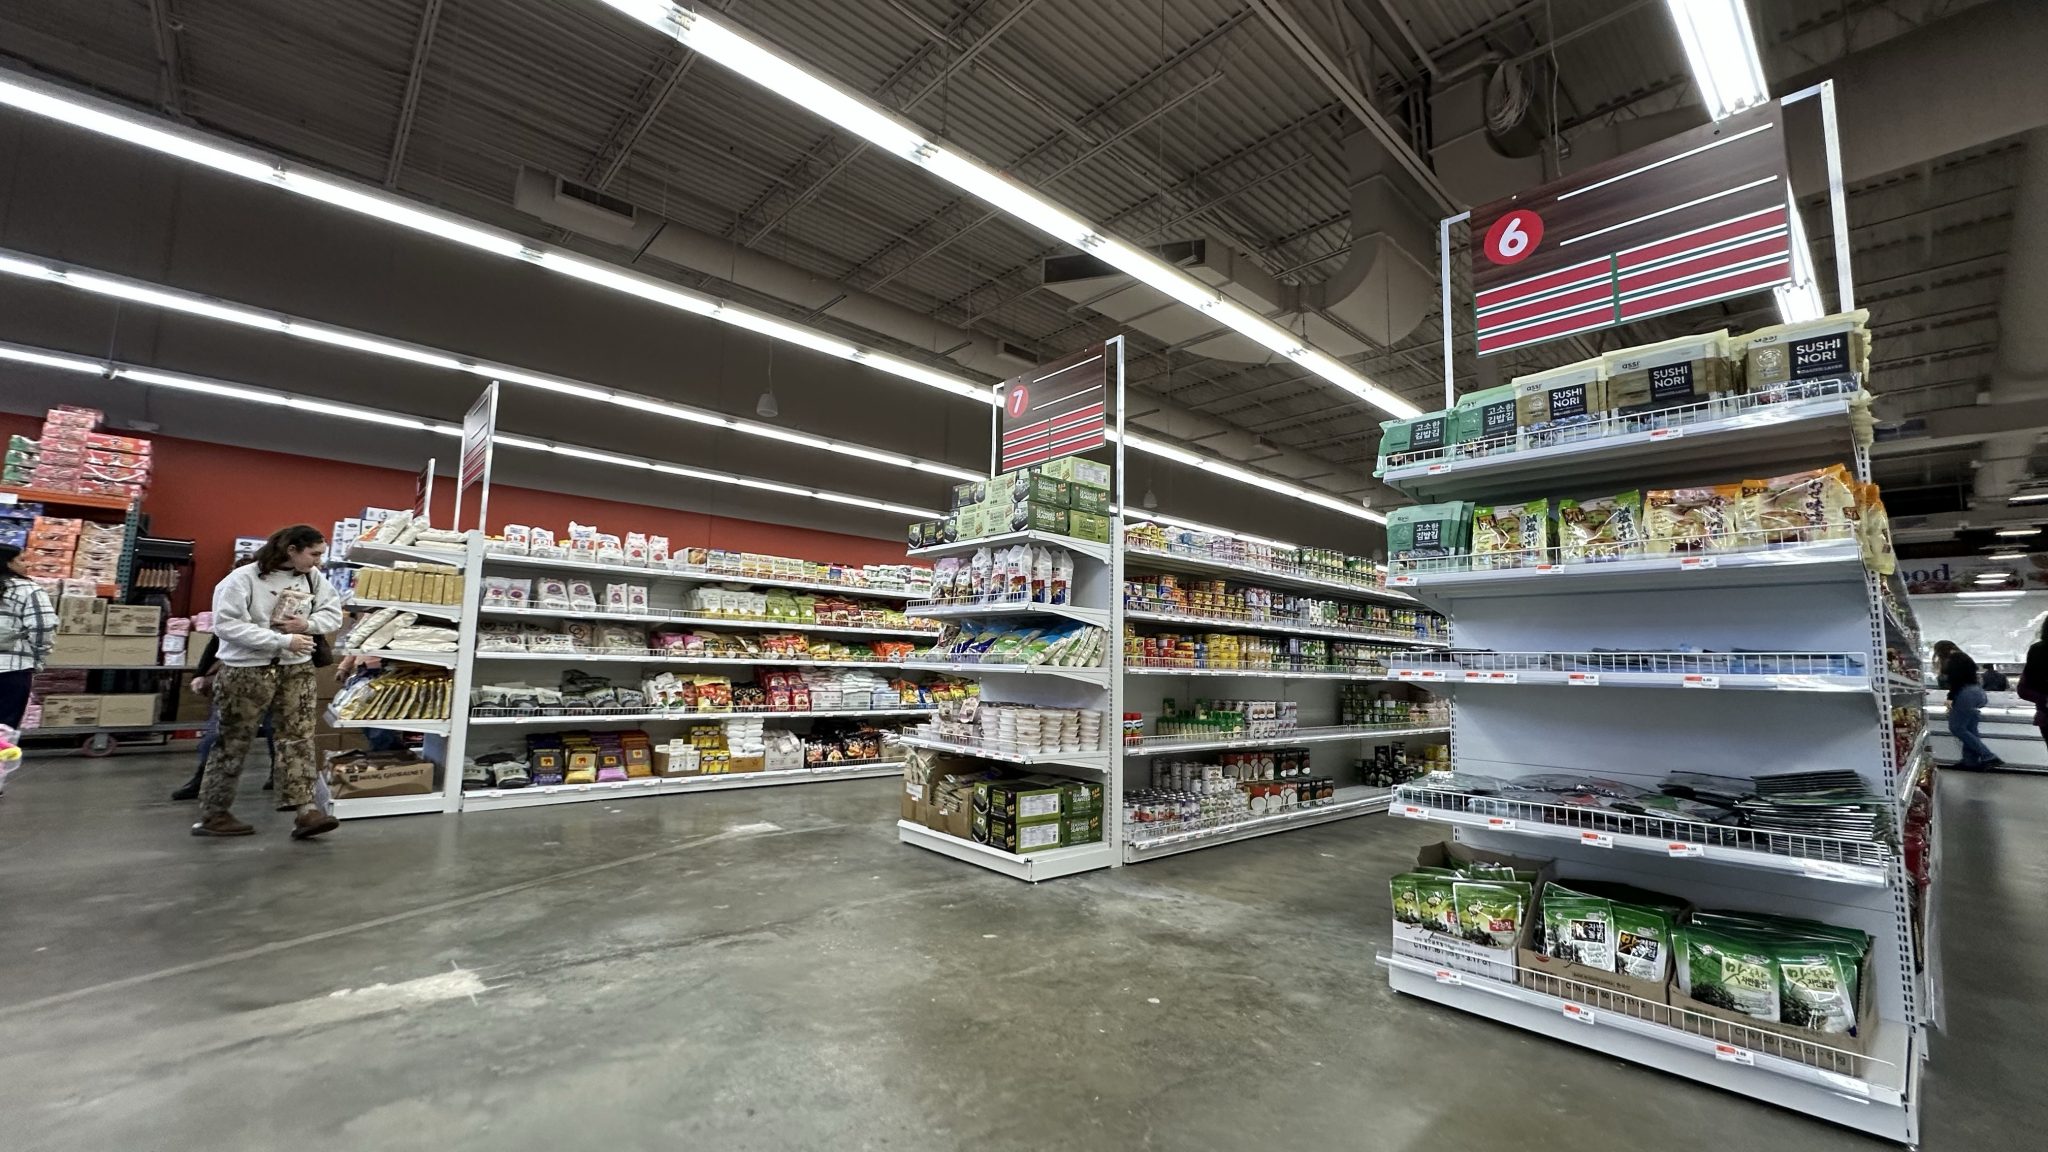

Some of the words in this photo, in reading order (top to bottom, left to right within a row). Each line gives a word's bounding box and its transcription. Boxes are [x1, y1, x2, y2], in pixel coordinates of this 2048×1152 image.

[1498, 217, 1529, 257] 6
[1796, 338, 1841, 355] SUSHI
[1797, 350, 1837, 365] NORI
[1653, 365, 1689, 380] SUSHI
[1654, 376, 1686, 389] NORI
[1552, 387, 1583, 400] SUSHI
[1013, 389, 1024, 413] 7
[1553, 396, 1580, 409] NORI
[1488, 402, 1515, 416] 고소한
[1488, 411, 1514, 425] 김밥김
[1415, 420, 1440, 432] 고소한
[1415, 428, 1440, 440] 김밥김
[1416, 522, 1439, 532] 고소한
[1416, 530, 1439, 540] 김밥김
